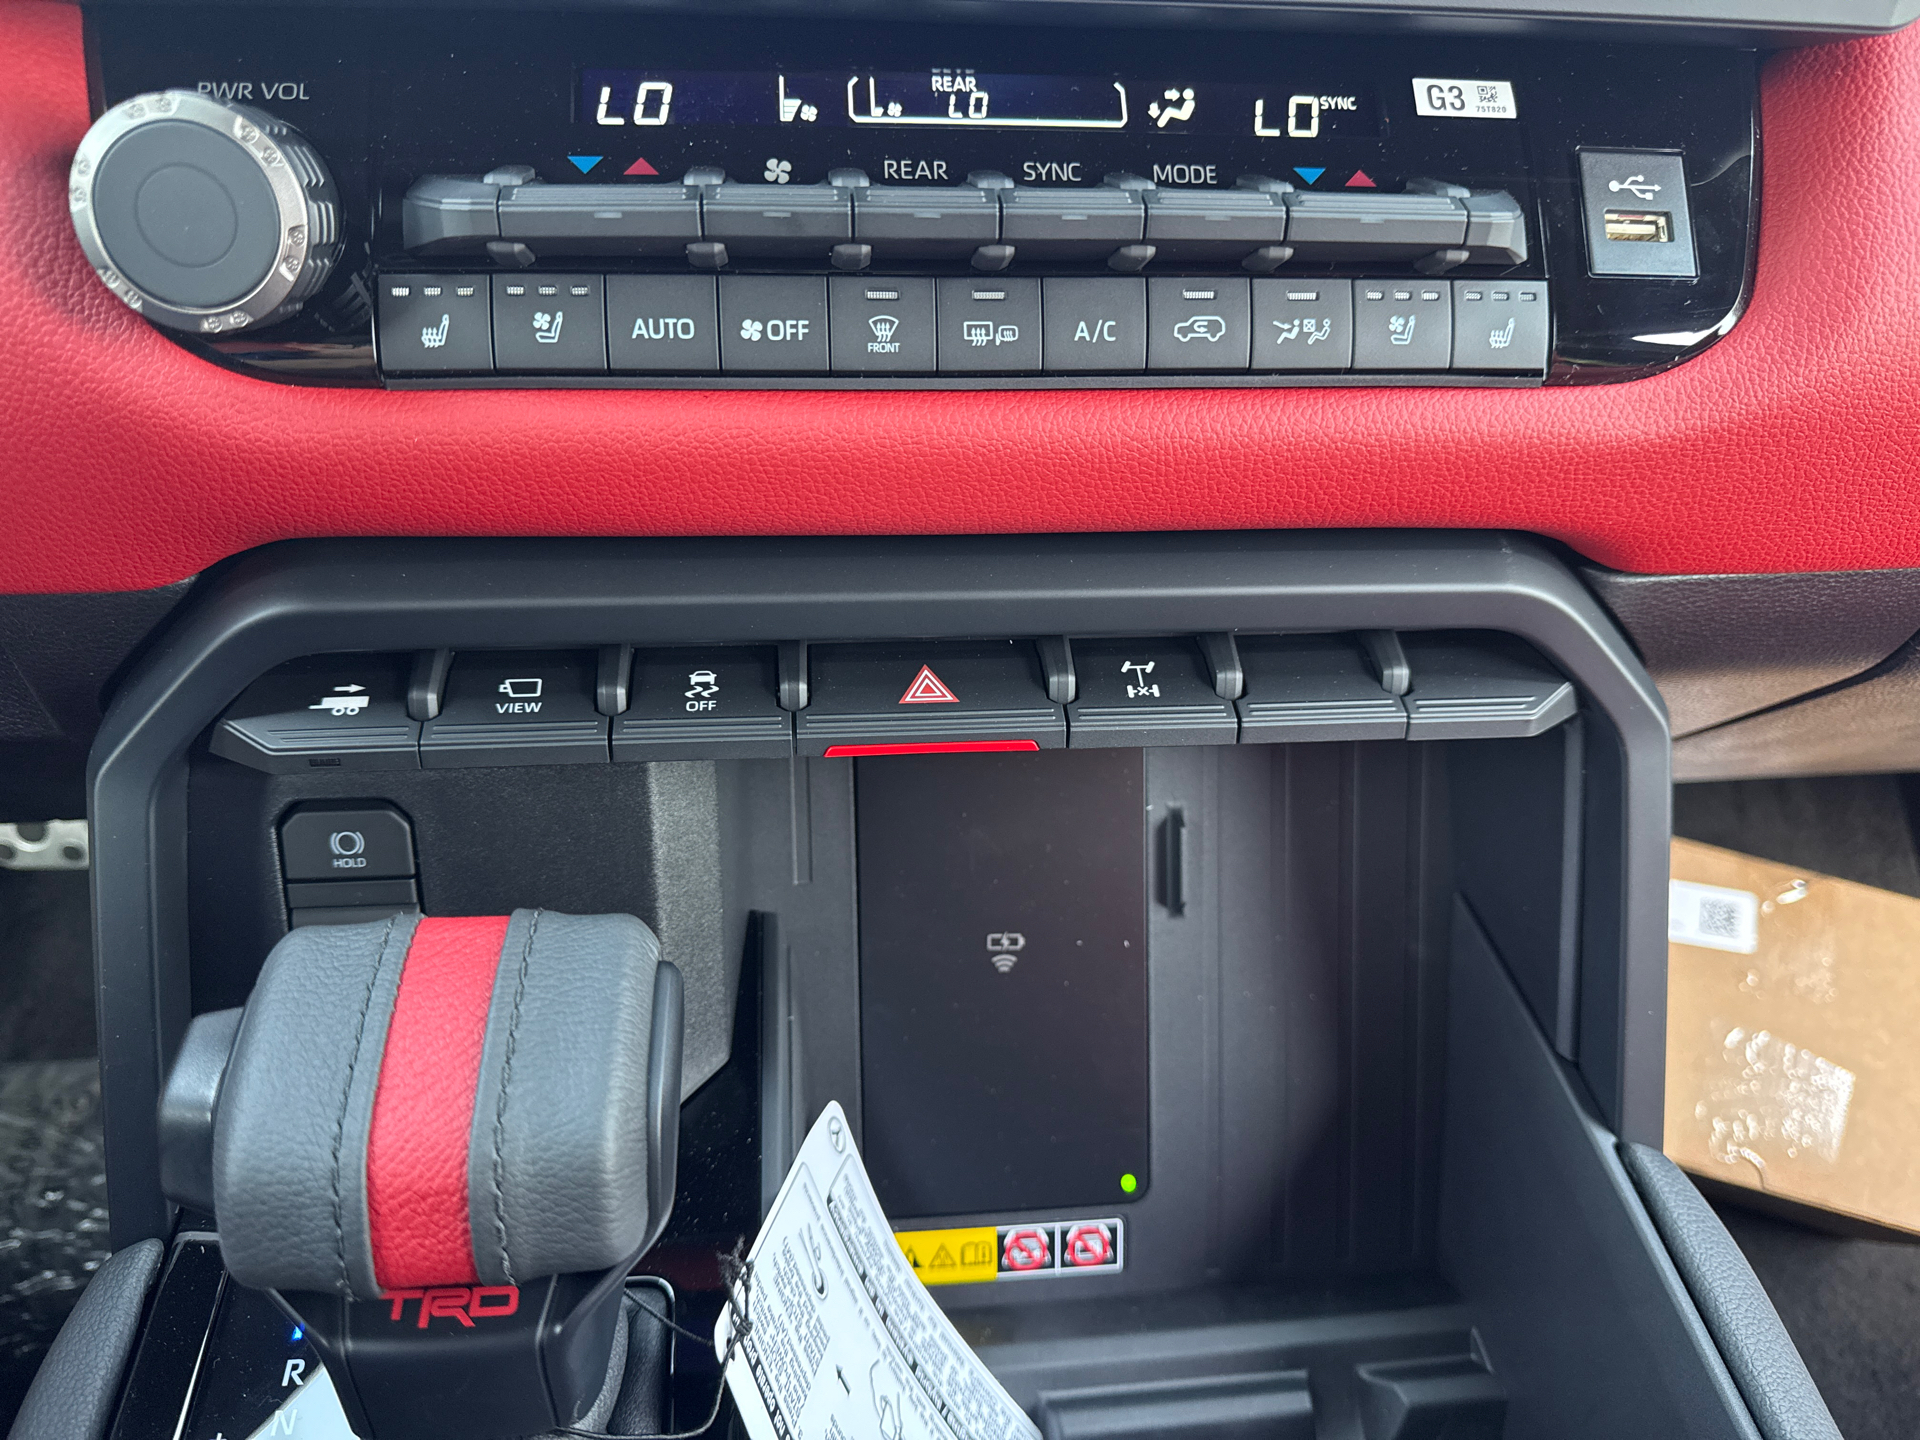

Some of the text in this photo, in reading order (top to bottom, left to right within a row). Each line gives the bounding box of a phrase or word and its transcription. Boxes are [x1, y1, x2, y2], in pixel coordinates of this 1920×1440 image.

[197, 82, 310, 100] PWR VOL
[932, 76, 977, 92] REAR
[596, 81, 673, 125] LO
[949, 91, 989, 118] LO
[1320, 96, 1357, 110] SYNC
[1426, 85, 1465, 110] G3
[1254, 95, 1319, 138] LO
[884, 161, 948, 180] REAR
[1023, 162, 1082, 182] SYNC
[1153, 164, 1217, 184] MODE
[631, 318, 695, 340] AUTO
[766, 320, 810, 341] OFF
[1074, 320, 1117, 342] A/C
[867, 343, 900, 353] FRONT
[495, 701, 542, 713] VIEW
[685, 701, 716, 712] OFF
[333, 857, 367, 869] HOLD
[380, 1285, 519, 1329] TRD
[281, 1358, 306, 1387] R
[773, 1371, 783, 1395] the
[754, 1359, 777, 1412] operate
[772, 1407, 786, 1436] not
[782, 1392, 798, 1429] Press
[270, 1408, 297, 1436] N
